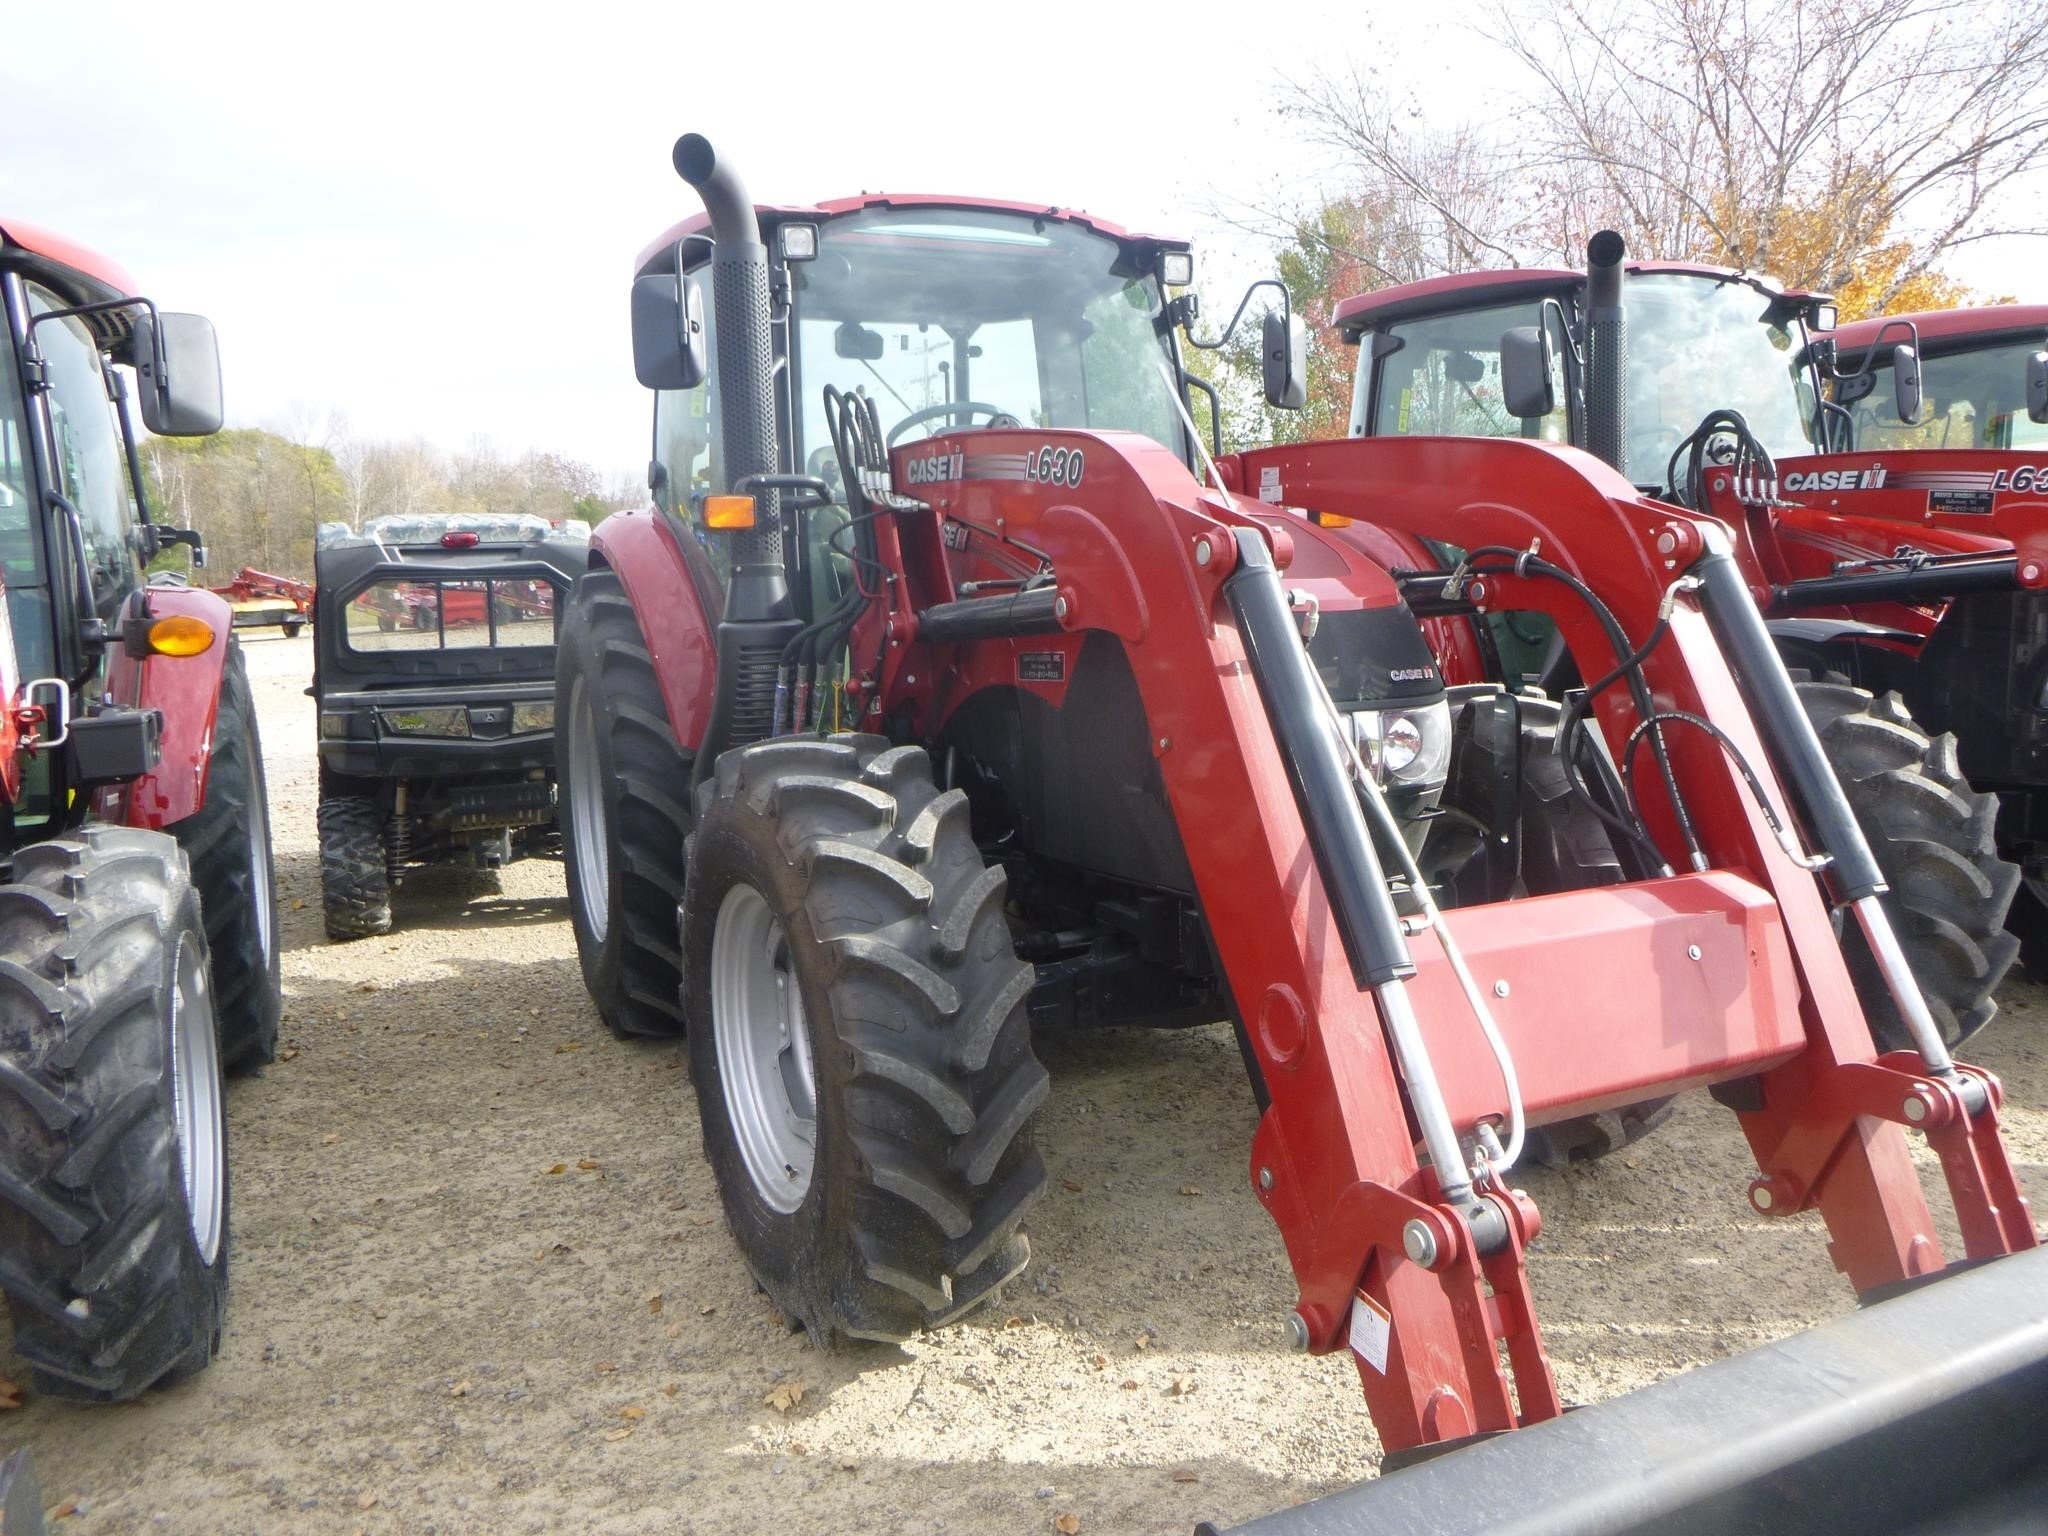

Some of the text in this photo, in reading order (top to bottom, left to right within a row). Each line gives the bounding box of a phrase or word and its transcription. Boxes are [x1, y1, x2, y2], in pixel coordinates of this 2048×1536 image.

[907, 455, 949, 484] CASE
[1025, 445, 1084, 489] L630
[1783, 470, 1859, 492] CASE
[1390, 668, 1423, 682] CASE
